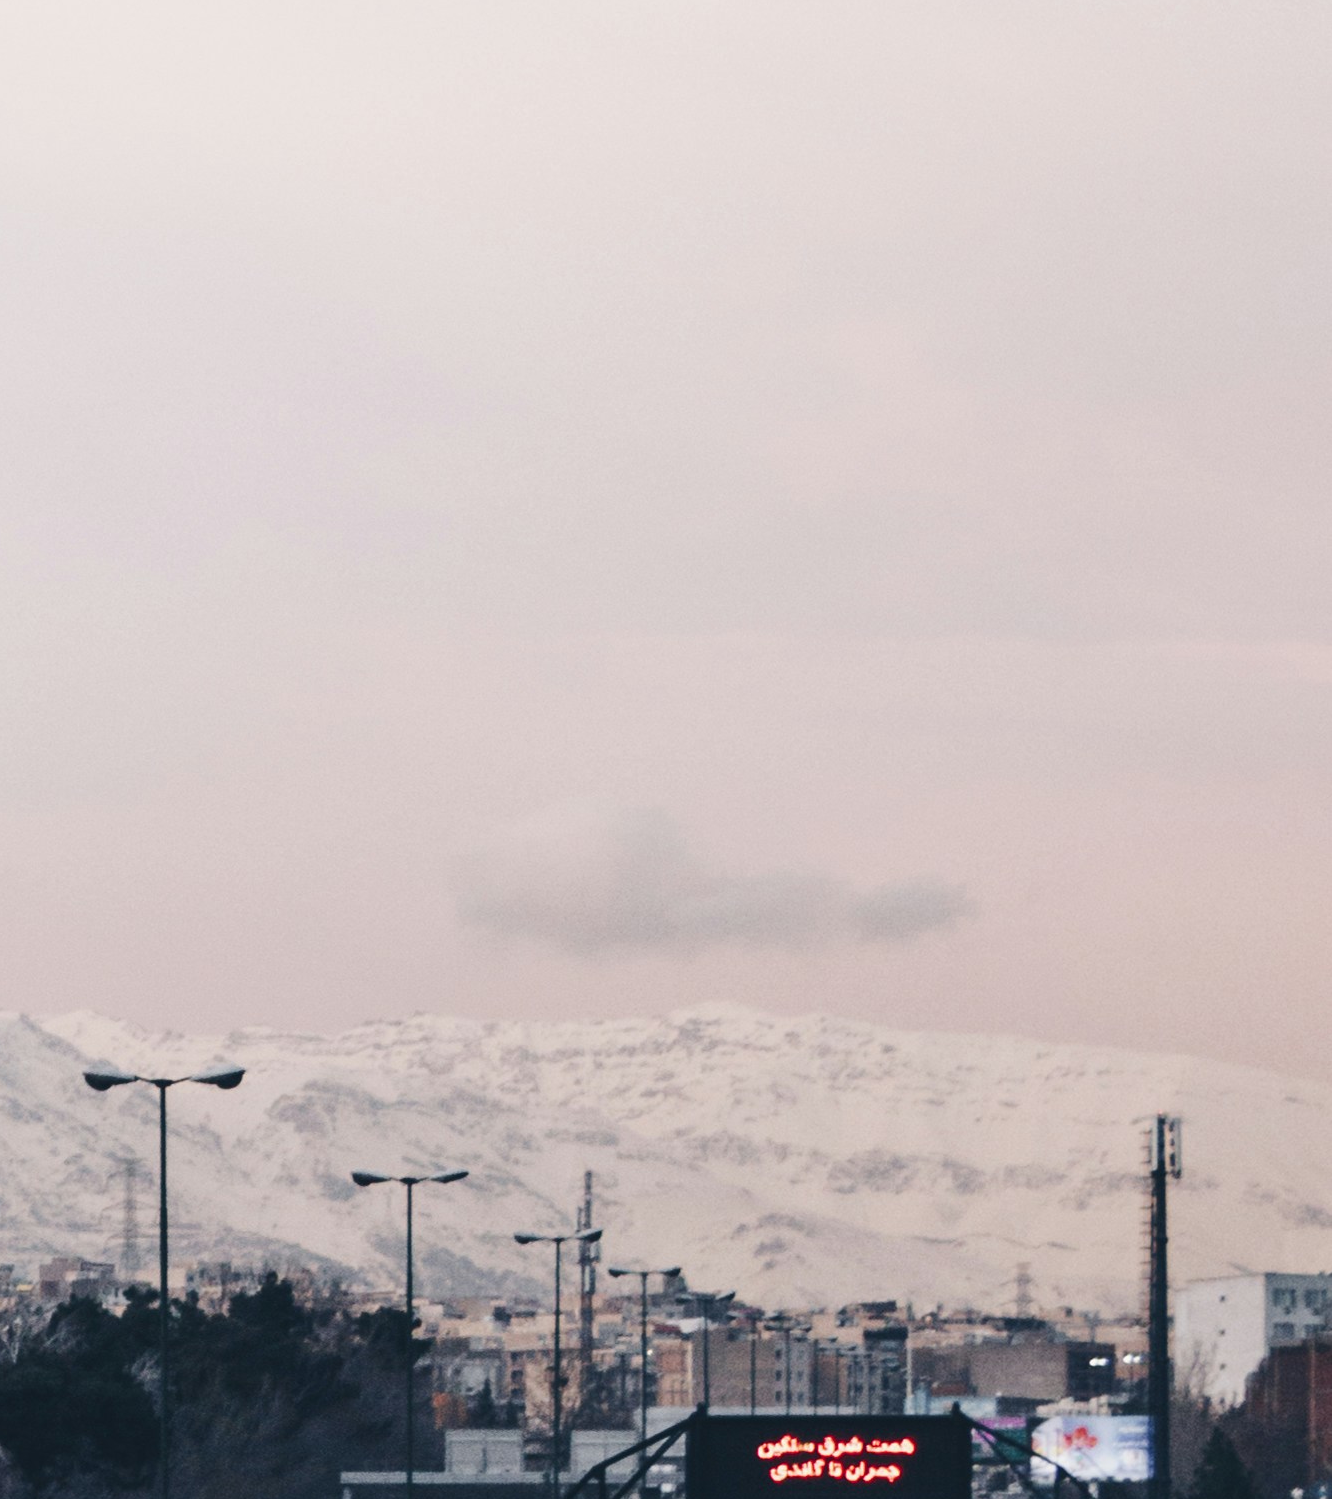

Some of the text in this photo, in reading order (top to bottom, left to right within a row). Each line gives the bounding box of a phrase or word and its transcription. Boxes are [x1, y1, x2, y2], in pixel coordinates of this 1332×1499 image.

[817, 1435, 864, 1458] شرق
[865, 1437, 915, 1455] همت
[769, 1457, 901, 1483] چمران تا گاندی
